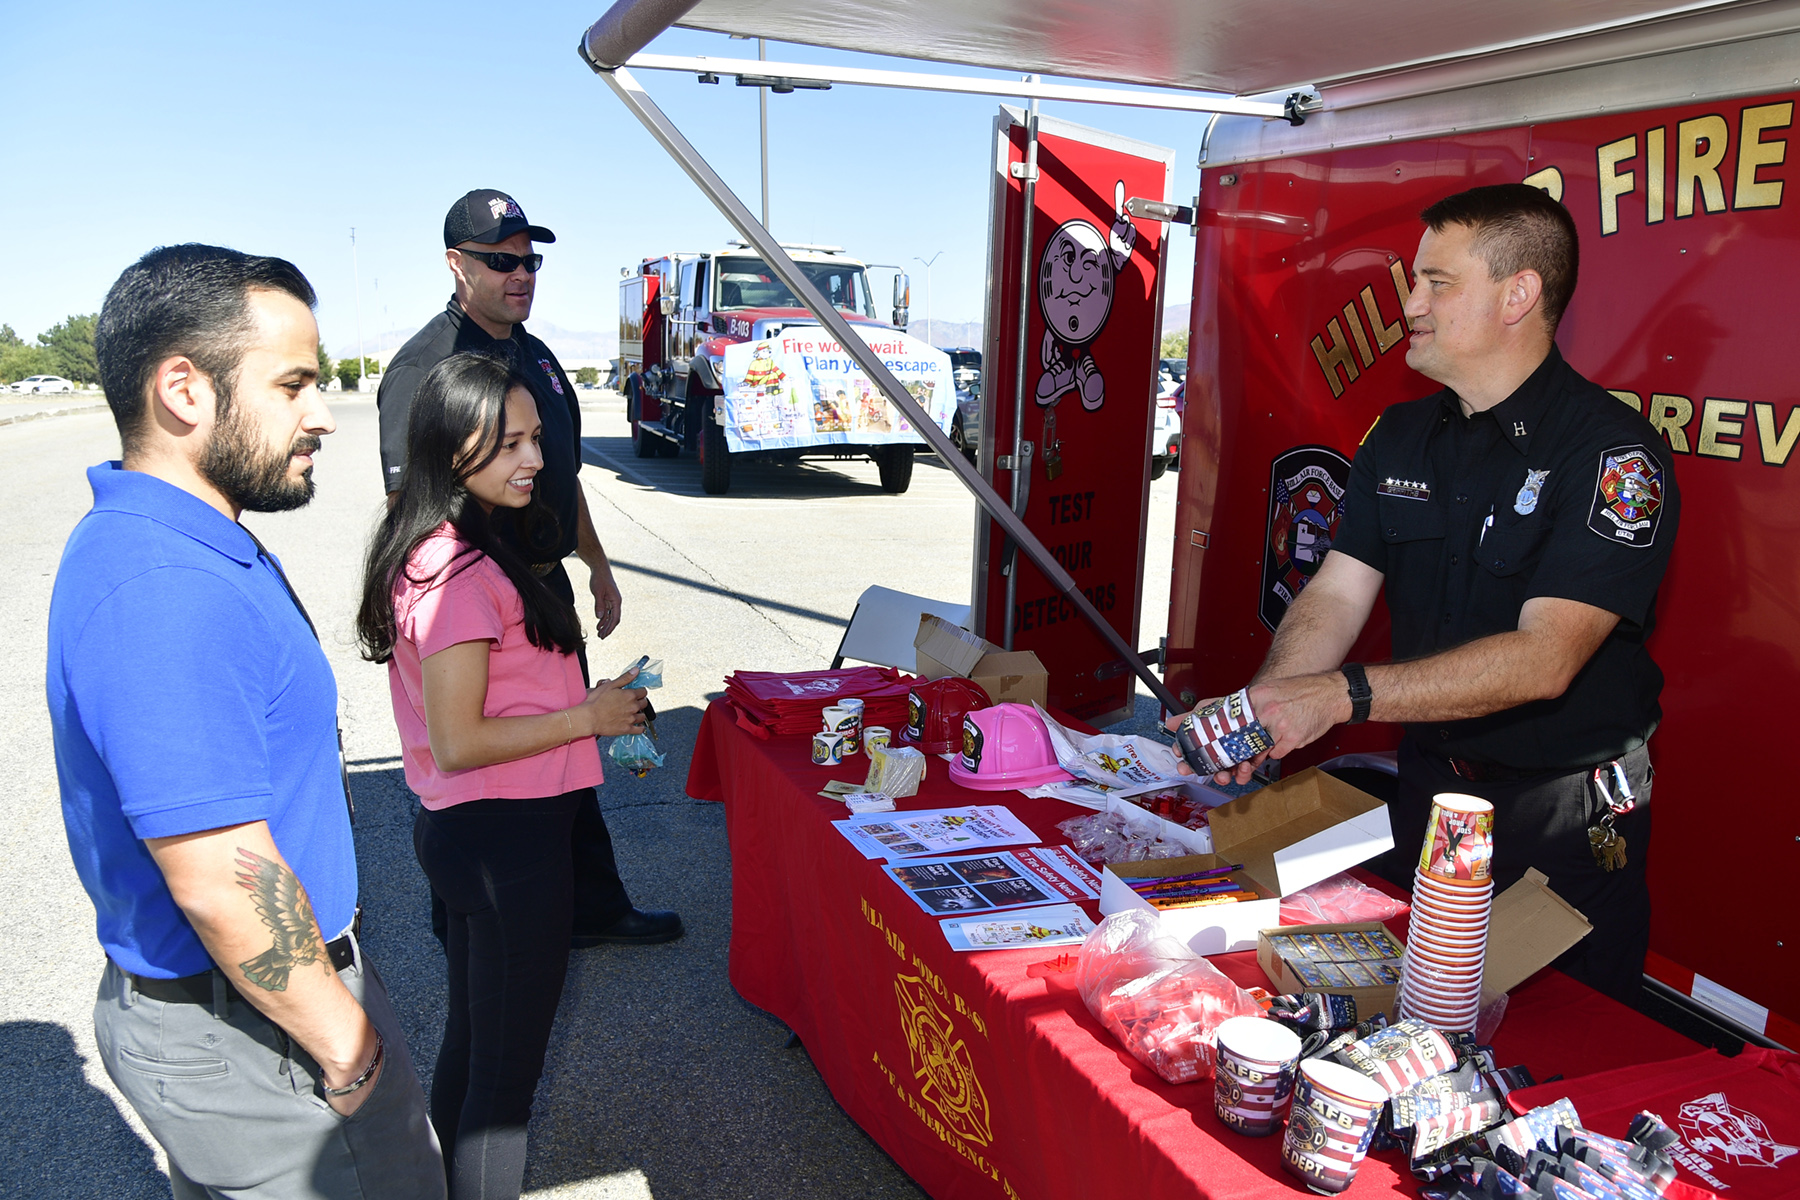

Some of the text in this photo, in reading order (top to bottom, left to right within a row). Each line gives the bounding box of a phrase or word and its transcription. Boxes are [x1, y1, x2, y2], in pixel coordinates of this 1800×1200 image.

[1596, 99, 1795, 238] FIRE
[730, 318, 750, 338] B-103
[783, 339, 814, 354] Fire
[869, 340, 908, 355] wait.
[803, 356, 839, 371] Plan
[887, 359, 942, 375] escape.
[1300, 468, 1311, 481] AIR
[1310, 468, 1331, 485] FORCE
[1328, 480, 1343, 497] BASE
[1049, 491, 1095, 525] TEST
[1230, 692, 1242, 719] AFB
[1250, 731, 1268, 751] FIRE
[1123, 743, 1157, 777] Fire won't
[1129, 766, 1147, 779] Plan
[967, 808, 982, 818] Fire
[1448, 818, 1465, 827] DROP
[1456, 827, 1473, 835] STOP
[1024, 858, 1040, 868] Fire
[1036, 866, 1060, 883] Safety
[1056, 881, 1078, 896] News
[1057, 855, 1071, 865] Fire
[1067, 864, 1091, 880] Safety
[885, 927, 906, 961] AIR
[1395, 1020, 1437, 1061] HILL AFB
[1225, 1059, 1264, 1083] AFB
[1218, 1104, 1248, 1129] DEPT.
[1310, 1097, 1354, 1130] AFB
[908, 1092, 999, 1182] EMERGENCY
[1313, 1131, 1324, 1146] D
[1290, 1149, 1325, 1180] DEPT.
[1662, 1146, 1731, 1190] EPARTMENT
[1687, 1153, 1714, 1171] AFB
